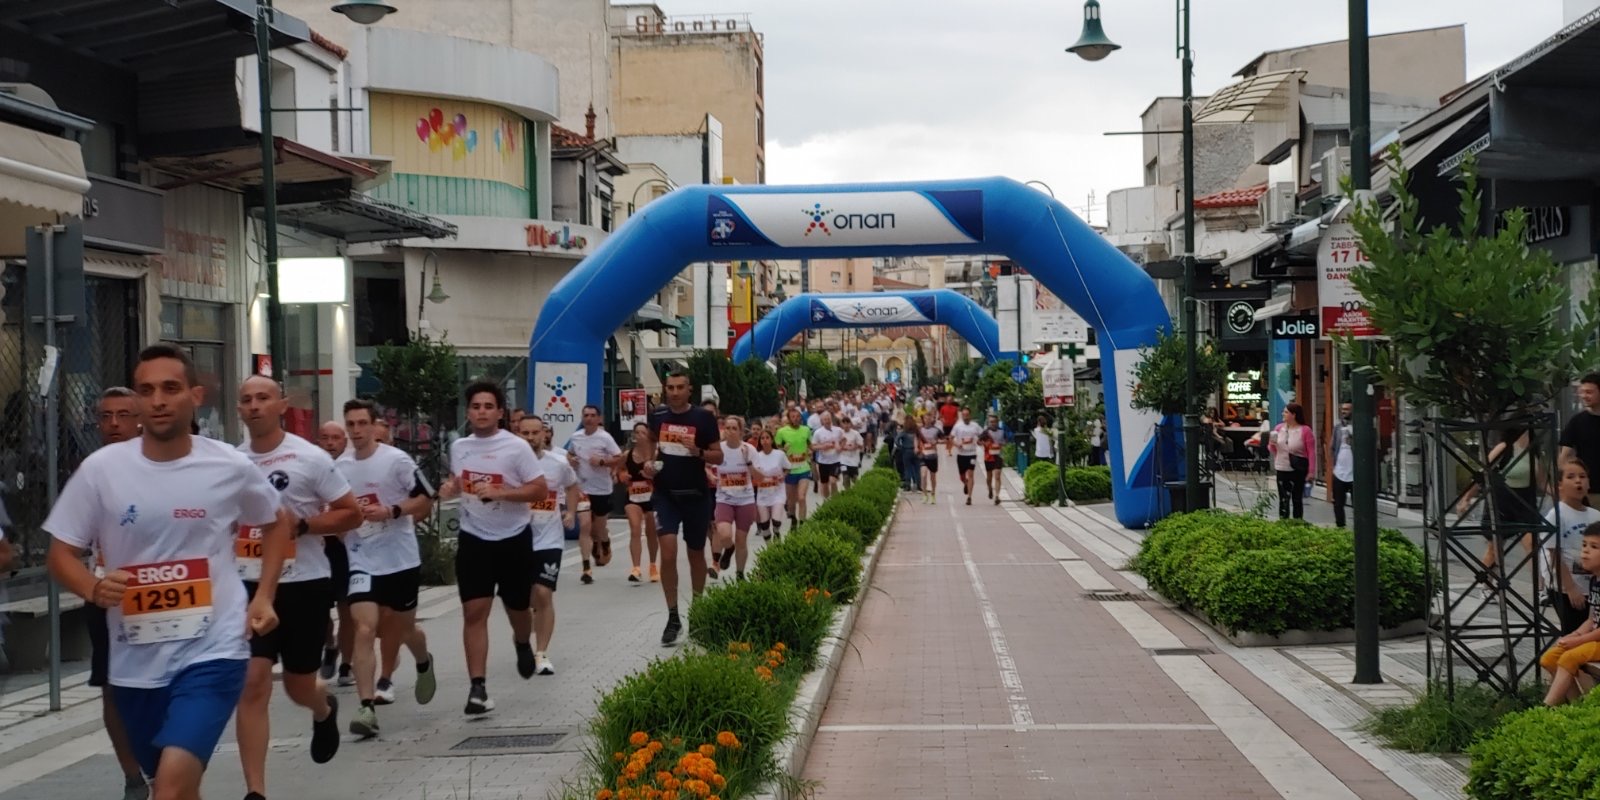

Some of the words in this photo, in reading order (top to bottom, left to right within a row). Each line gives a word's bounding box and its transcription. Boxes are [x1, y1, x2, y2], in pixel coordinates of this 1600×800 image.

[1330, 241, 1358, 250] ΣΑΒΒΑ
[1331, 250, 1350, 263] 17
[1276, 320, 1316, 336] Jolie
[173, 508, 207, 519] ERGO
[136, 563, 189, 585] ERGO
[133, 586, 197, 612] 1291
